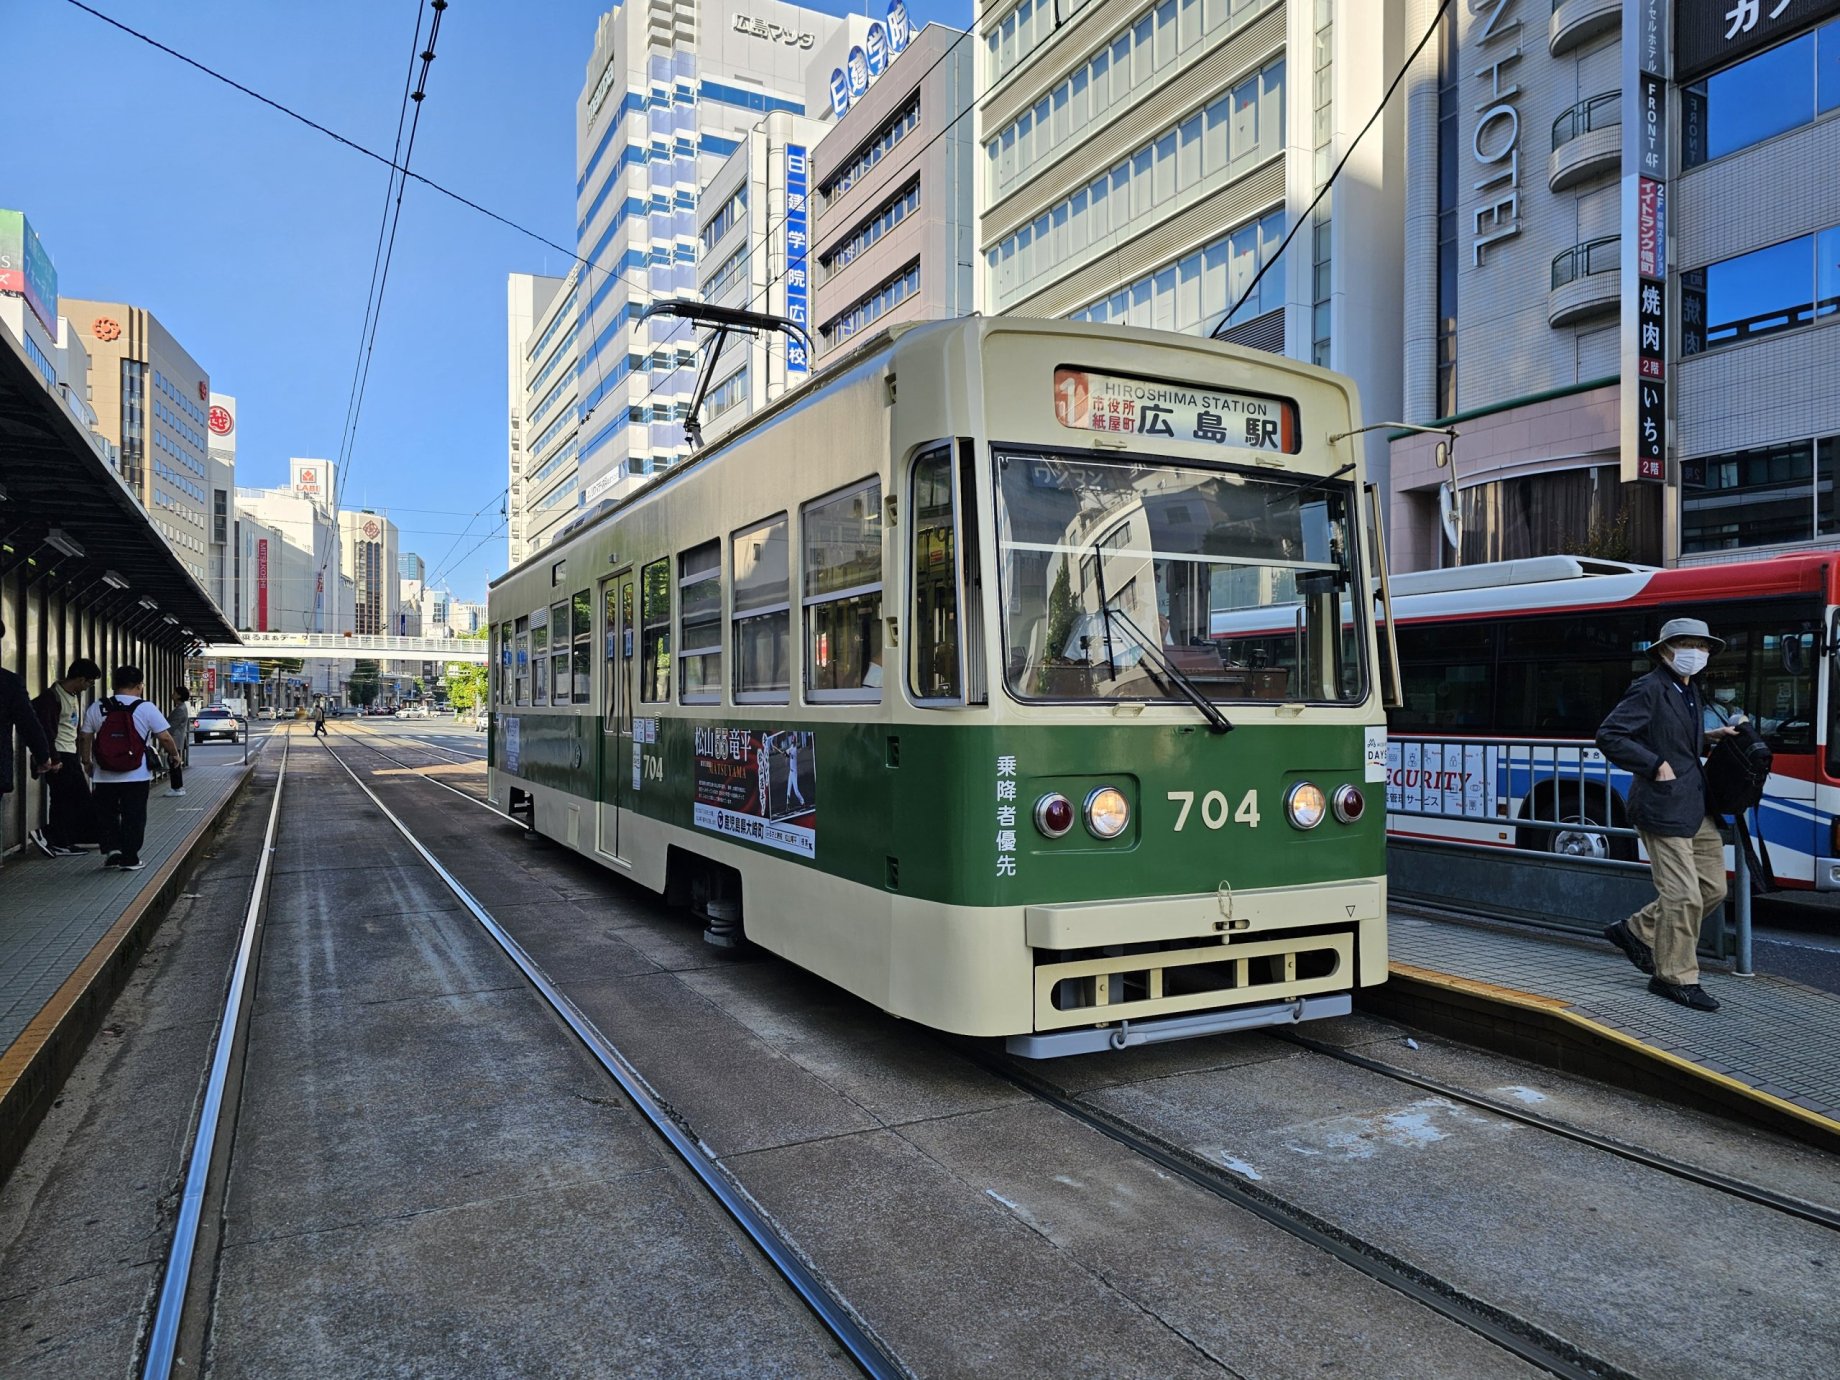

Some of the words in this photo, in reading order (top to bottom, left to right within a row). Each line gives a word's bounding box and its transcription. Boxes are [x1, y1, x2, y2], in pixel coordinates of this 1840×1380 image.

[731, 13, 815, 50] 広島マツダ
[831, 3, 908, 113] 日建学院
[1647, 84, 1657, 149] FRONT
[1474, 47, 1523, 268] HOTEL
[1645, 152, 1659, 169] 4F
[1656, 184, 1664, 208] 2F
[1641, 284, 1661, 352] 焼肉
[1643, 360, 1659, 375] 2階
[1092, 396, 1135, 417] 市役所
[1104, 381, 1197, 408] HIROSHIMA
[1201, 395, 1267, 417] STATION
[1092, 414, 1135, 434] 紙屋町
[1138, 403, 1279, 450] 広島駅
[1643, 387, 1659, 455] いち。
[1643, 461, 1659, 476] 2階
[259, 542, 267, 588] MITSUKOSHI
[643, 755, 664, 782] 704
[996, 755, 1017, 877] 乗降者優先
[1167, 789, 1260, 832] 704
